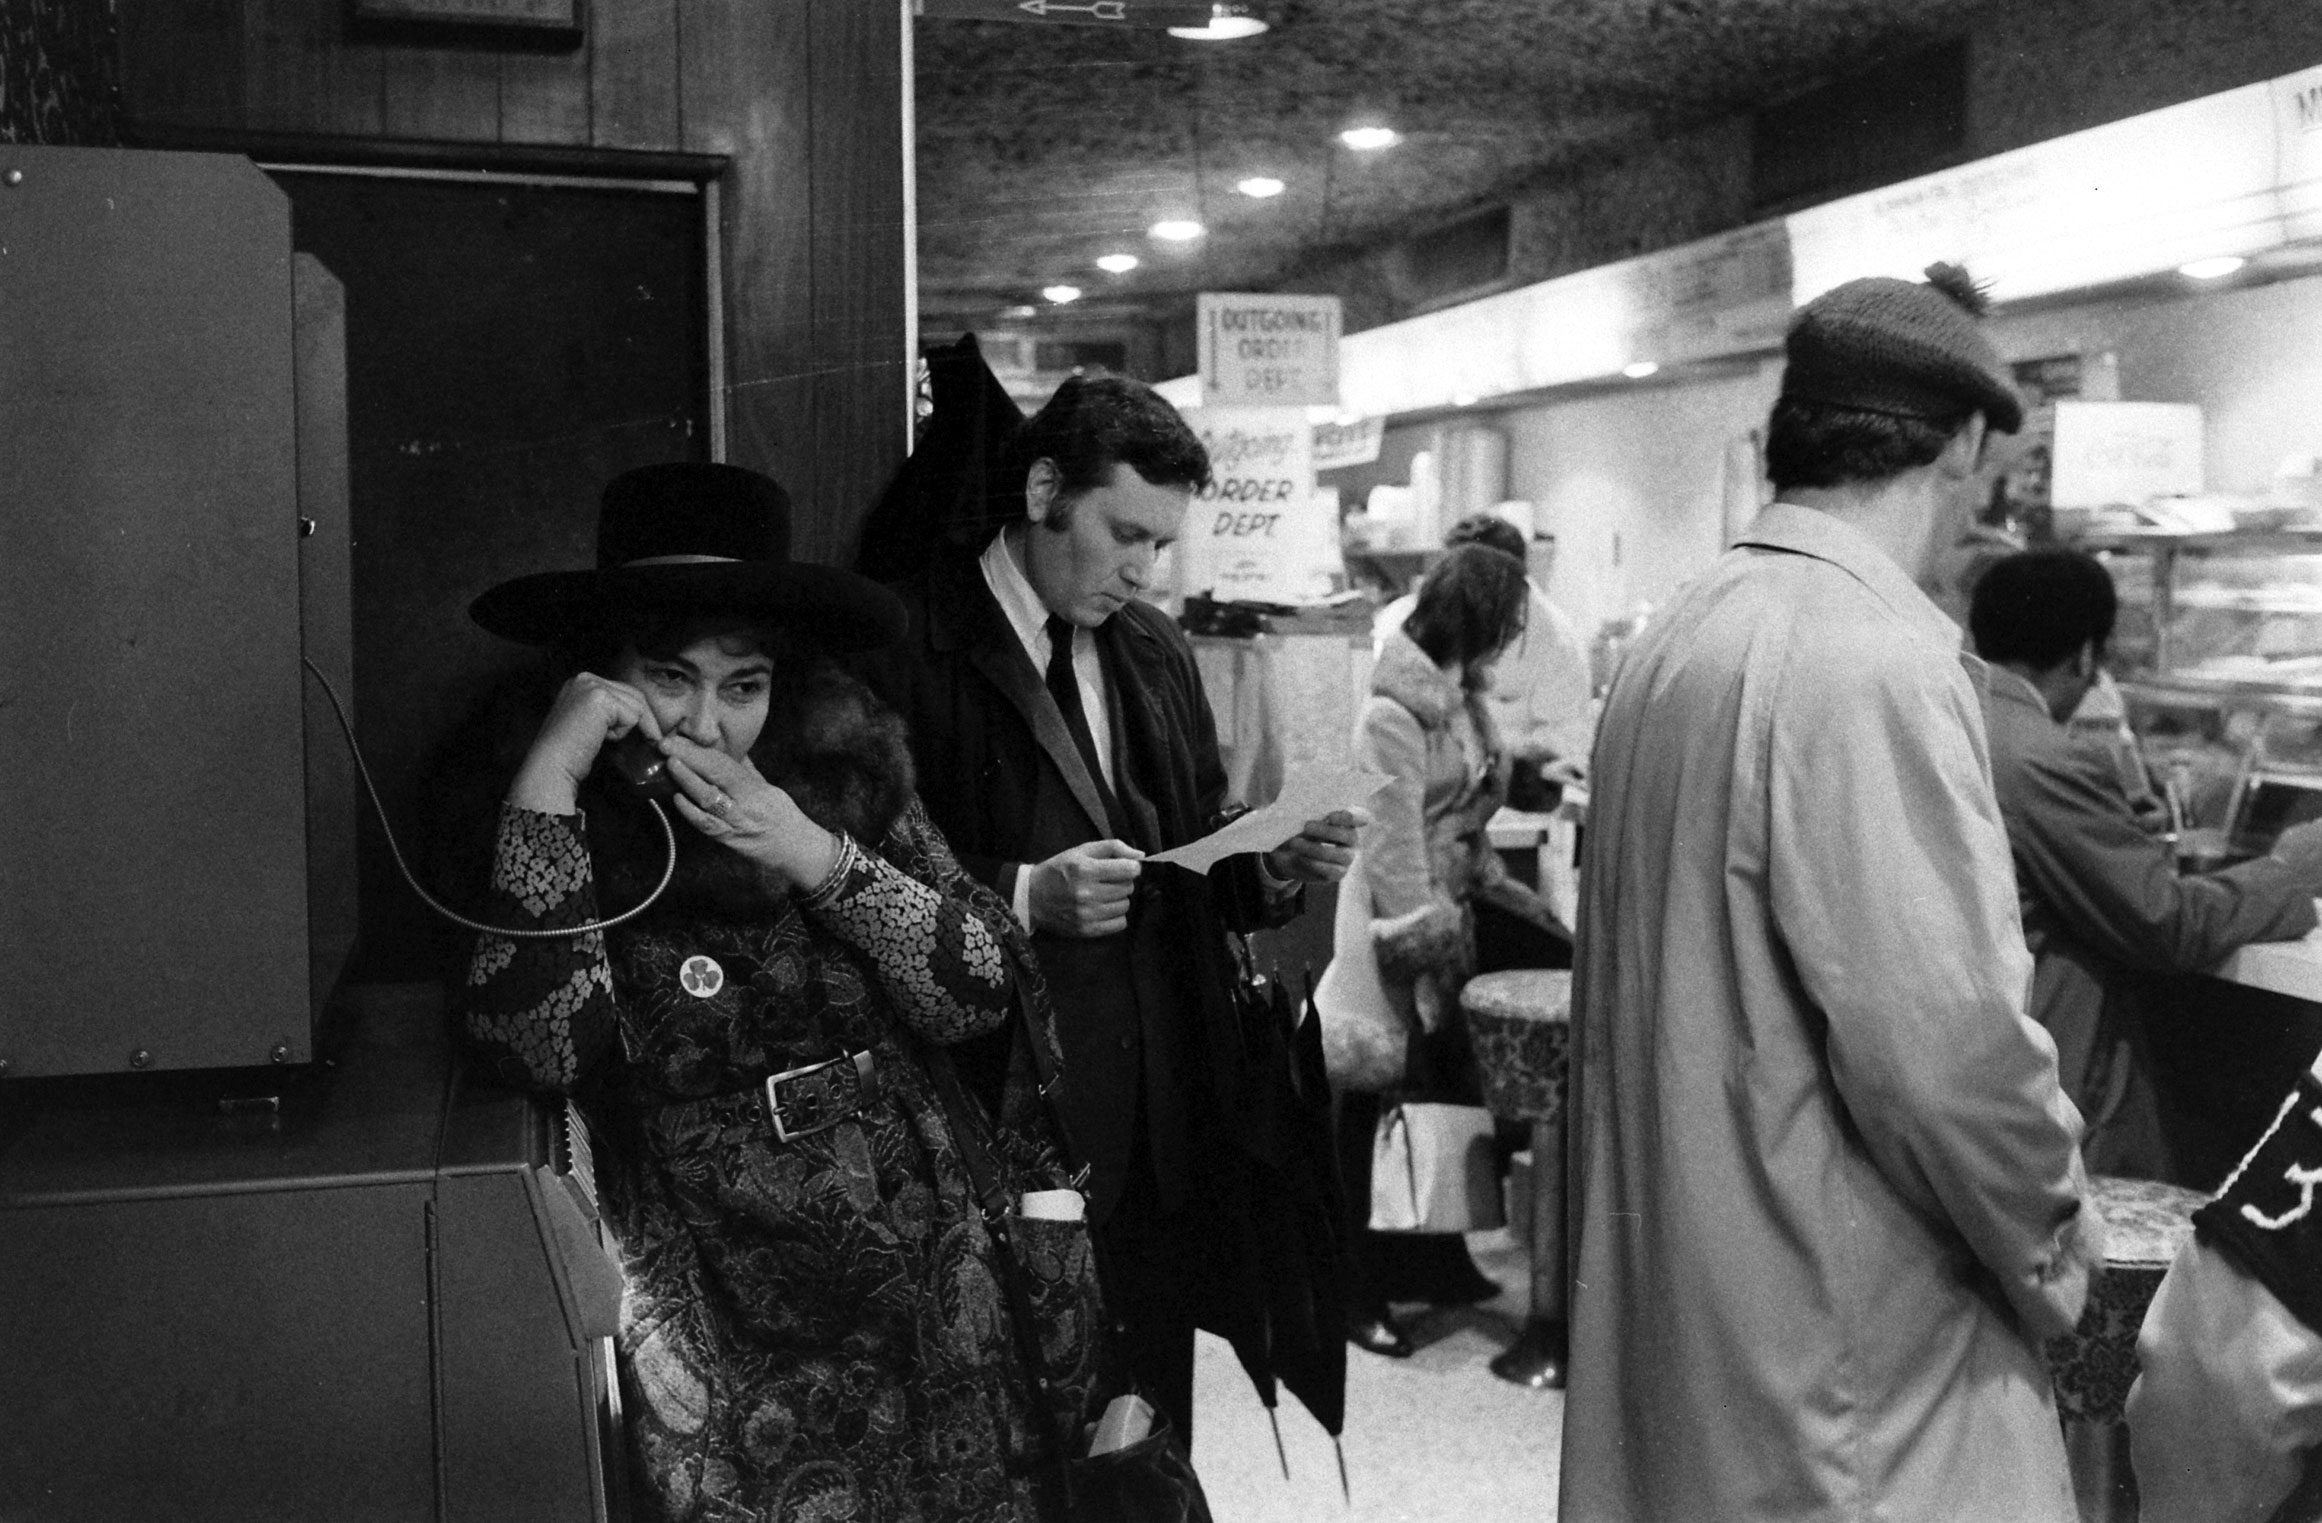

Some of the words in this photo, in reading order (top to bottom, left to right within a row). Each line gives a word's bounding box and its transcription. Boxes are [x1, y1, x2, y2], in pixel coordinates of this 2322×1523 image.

[1221, 308, 1321, 332] OUTGOING
[1201, 478, 1293, 502] ORDER
[1212, 512, 1281, 537] DEPT
